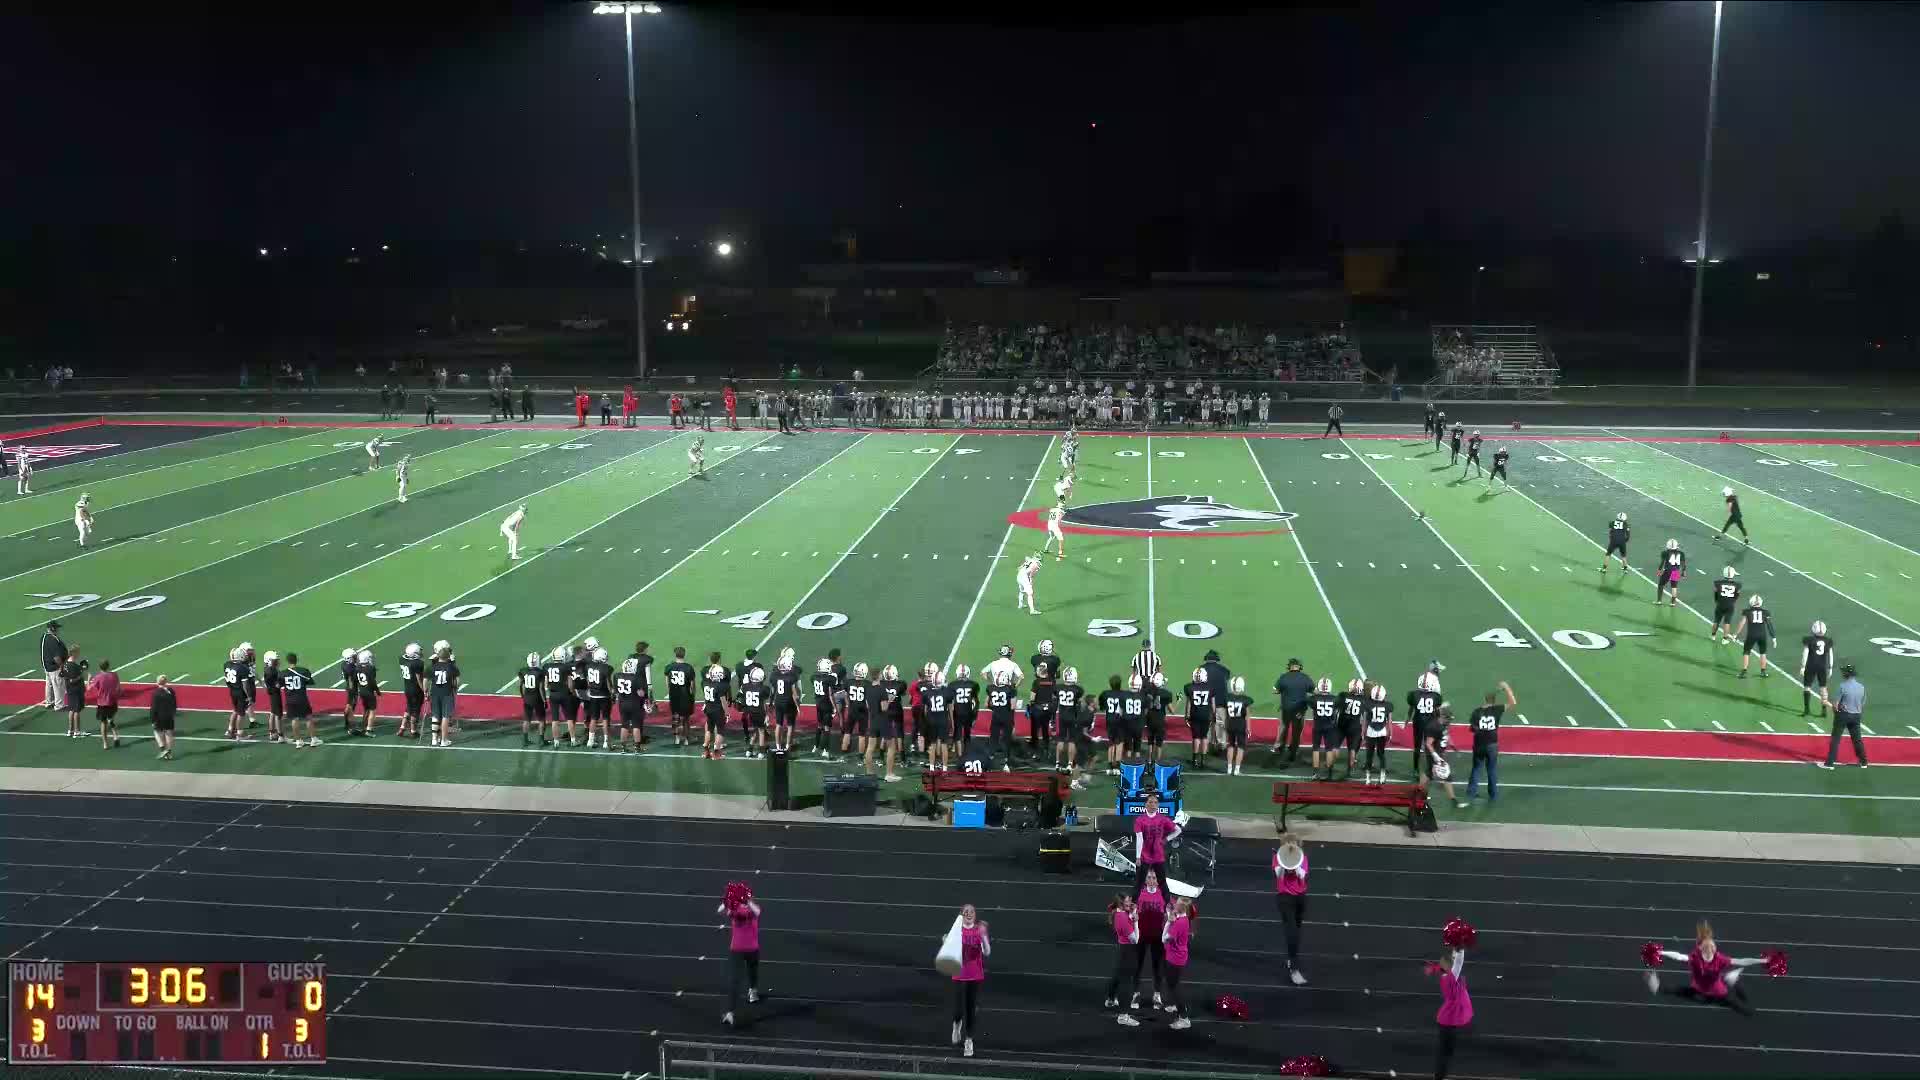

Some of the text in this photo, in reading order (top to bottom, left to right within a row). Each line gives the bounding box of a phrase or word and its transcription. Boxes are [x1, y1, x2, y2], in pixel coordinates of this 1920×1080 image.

[1668, 554, 1681, 566] 44
[1720, 584, 1735, 598] 52
[1752, 610, 1763, 624] 11
[1087, 618, 1219, 639] 50
[1472, 628, 1610, 649] 40
[1816, 640, 1825, 655] 3
[224, 667, 236, 684] 36
[524, 674, 535, 688] 10
[548, 667, 560, 682] 16
[671, 671, 685, 686] 58
[285, 676, 301, 690] 50
[617, 678, 632, 694] 53
[777, 680, 785, 694] 8
[813, 680, 825, 695] 81
[704, 686, 715, 701] 61
[745, 691, 759, 707] 85
[849, 686, 864, 701] 56
[956, 688, 972, 703] 25
[991, 691, 1007, 706] 23
[1059, 691, 1074, 706] 22
[1193, 691, 1209, 705] 57
[930, 696, 944, 712] 12
[1125, 698, 1141, 714] 68
[1226, 701, 1242, 717] 27
[1316, 701, 1333, 717] 55
[1344, 698, 1361, 715] 76
[1417, 698, 1433, 714] 48
[1371, 706, 1385, 722] 15
